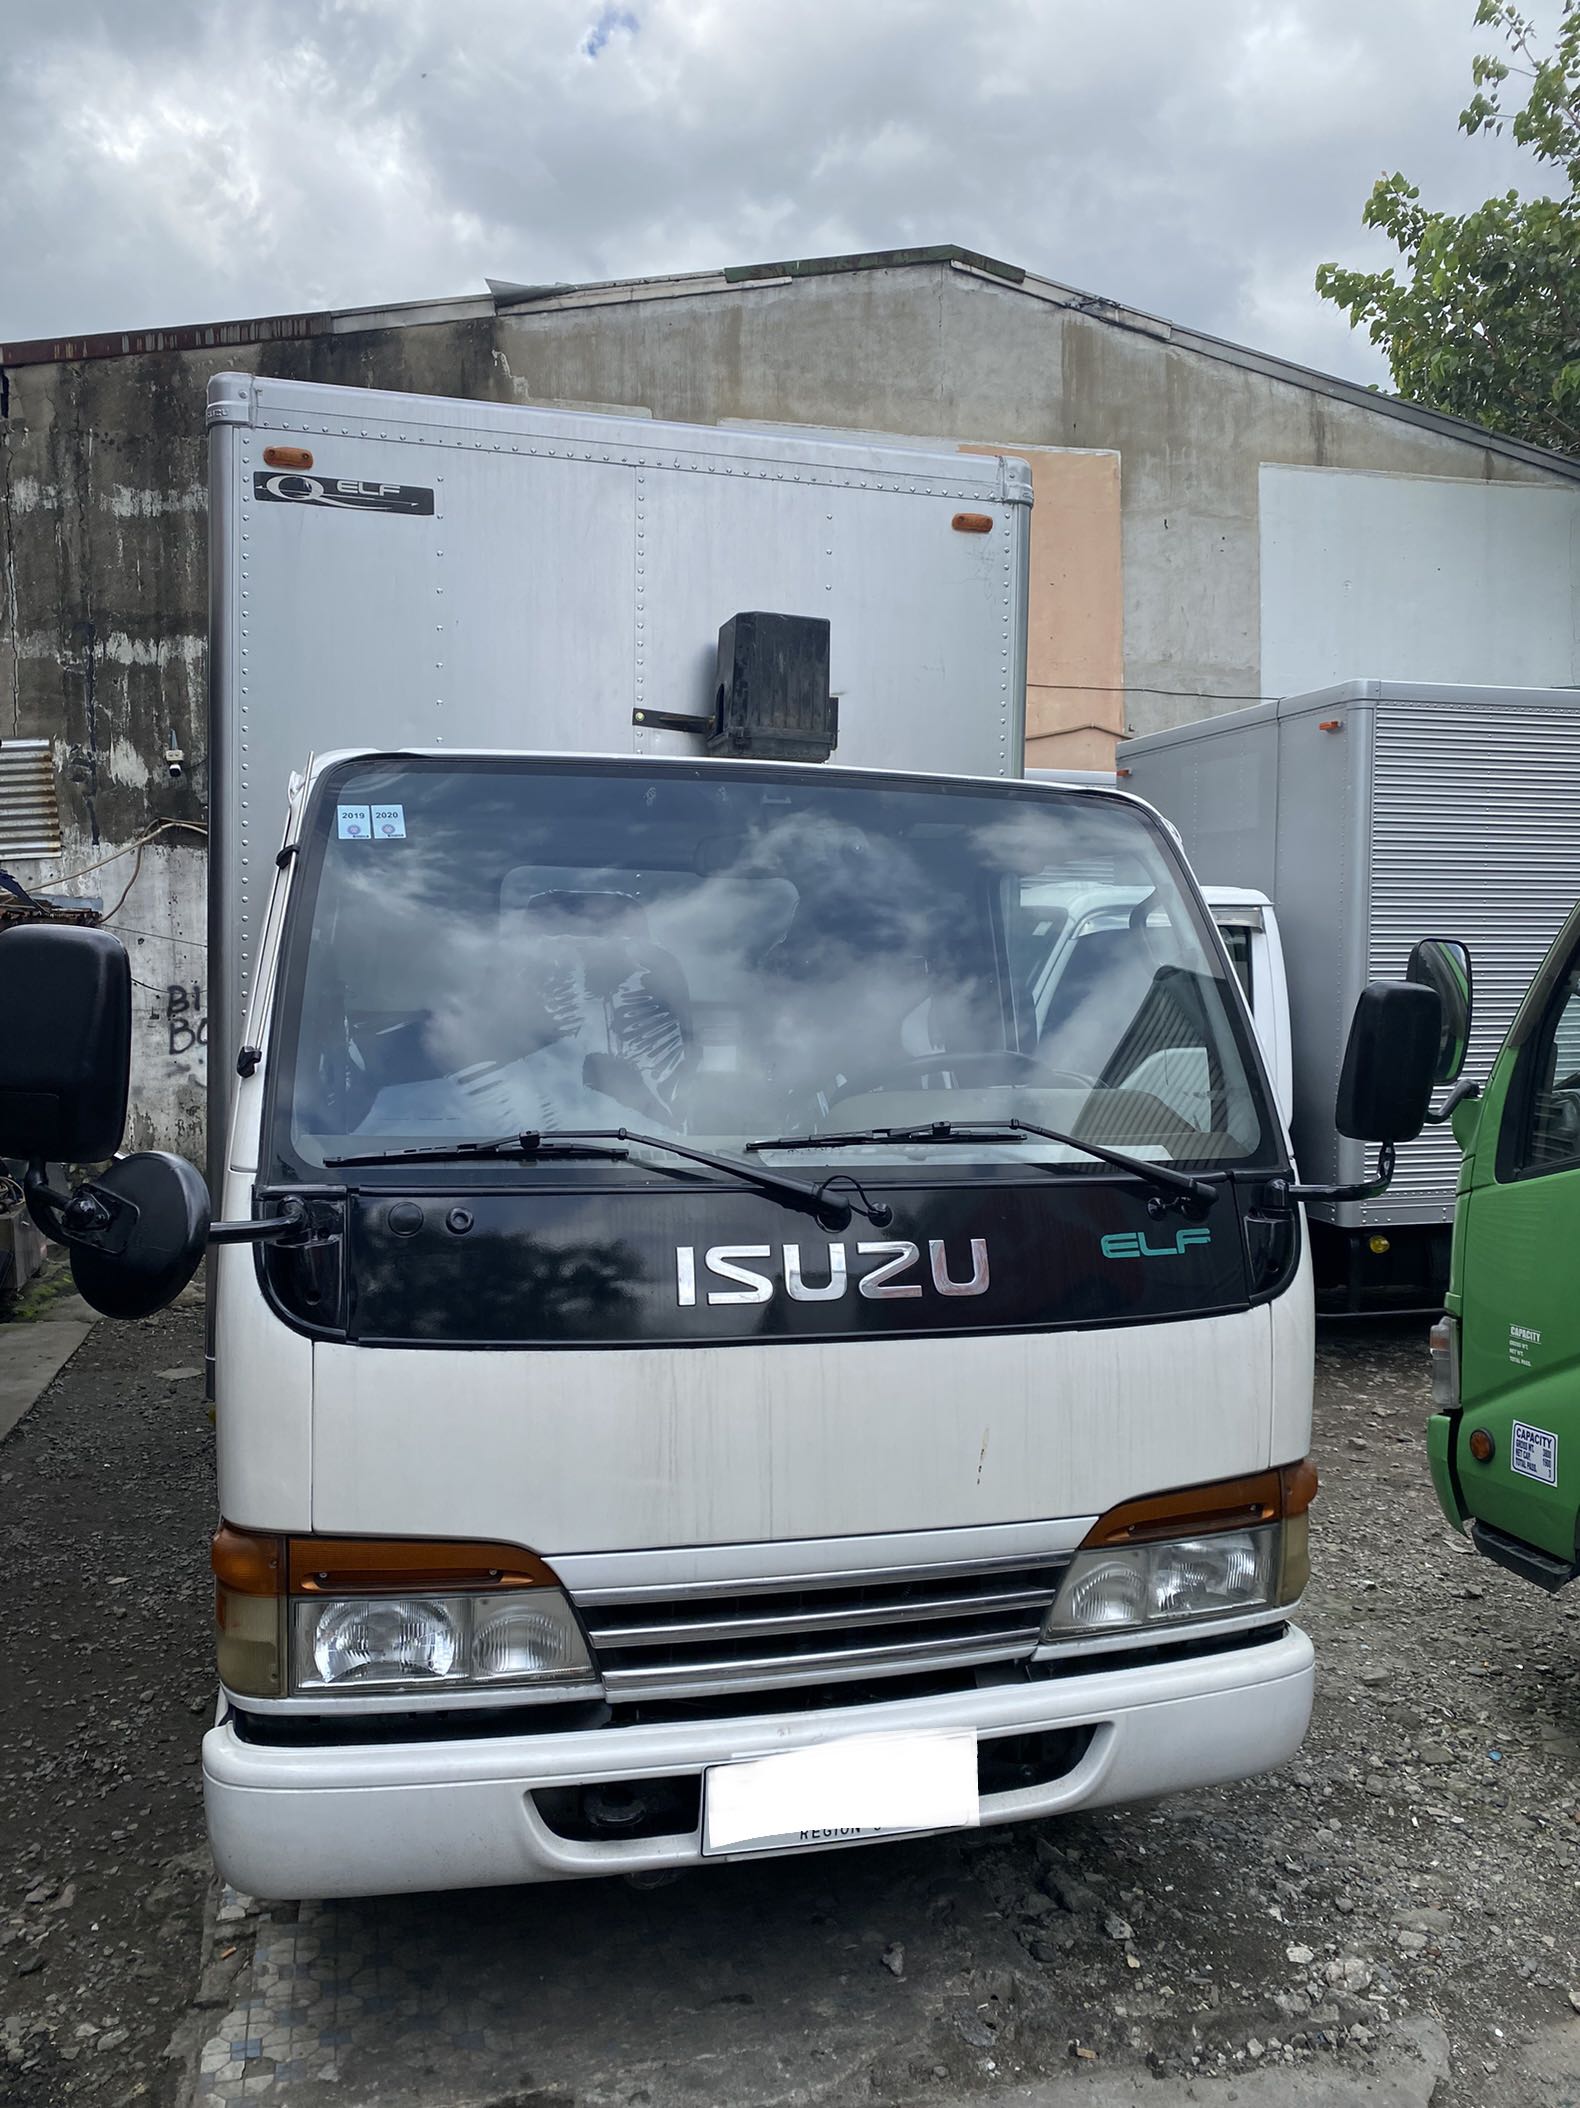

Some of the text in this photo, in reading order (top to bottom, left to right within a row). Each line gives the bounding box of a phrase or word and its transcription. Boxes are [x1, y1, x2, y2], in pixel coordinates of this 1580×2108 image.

[337, 480, 401, 497] ELF
[375, 811, 399, 819] 2020
[1100, 1227, 1212, 1259] ELF
[676, 1238, 990, 1307] ISUZU
[1510, 1326, 1541, 1342] CAPACITY
[1517, 1427, 1553, 1449] CAPACITY
